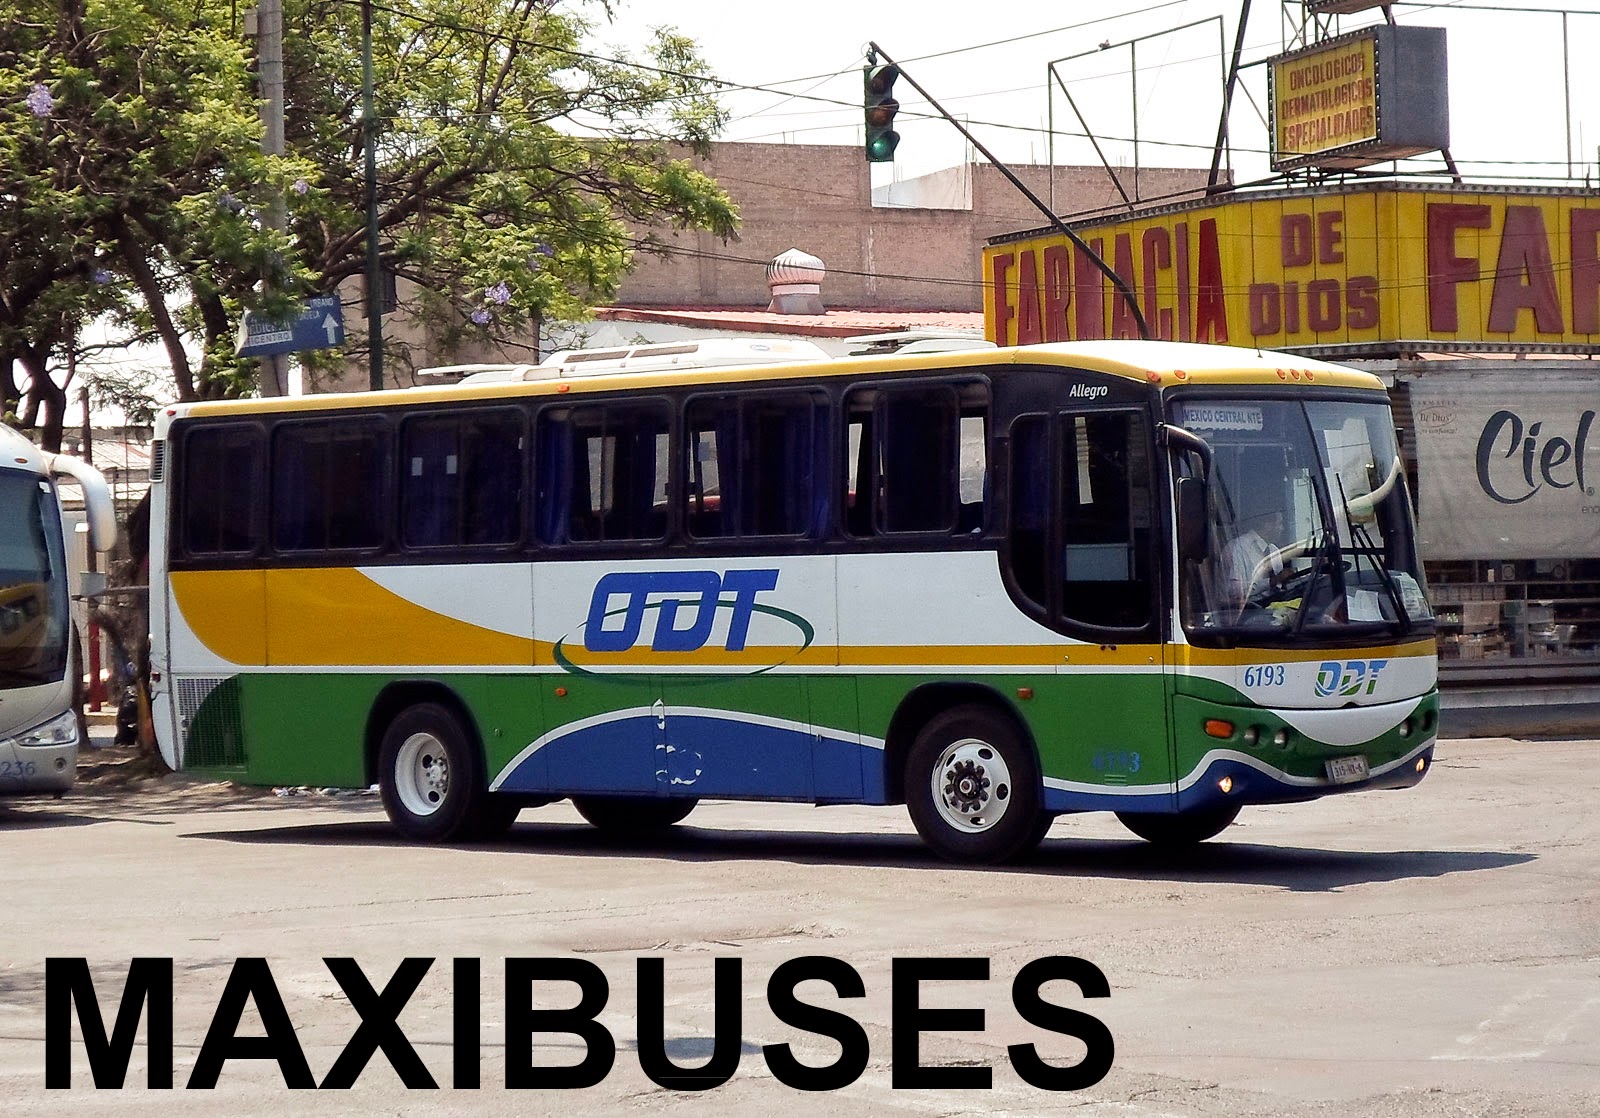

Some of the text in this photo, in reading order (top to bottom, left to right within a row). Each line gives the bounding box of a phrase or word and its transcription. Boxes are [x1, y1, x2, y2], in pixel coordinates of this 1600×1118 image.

[1290, 53, 1364, 91] ONCOLOGICOS
[1282, 77, 1372, 120] DERMATOLOGICOS
[1283, 105, 1373, 150] ESPECIALIDADES
[1281, 211, 1343, 267] DE
[993, 218, 1228, 346] FARMACIA
[1250, 276, 1379, 336] DIOS
[1069, 384, 1108, 400] Allegro
[1183, 409, 1213, 422] MEXICO
[1214, 410, 1246, 424] CENTRAL
[1475, 410, 1596, 504] Ciel
[584, 569, 780, 651] ODT
[1244, 665, 1286, 687] 6193
